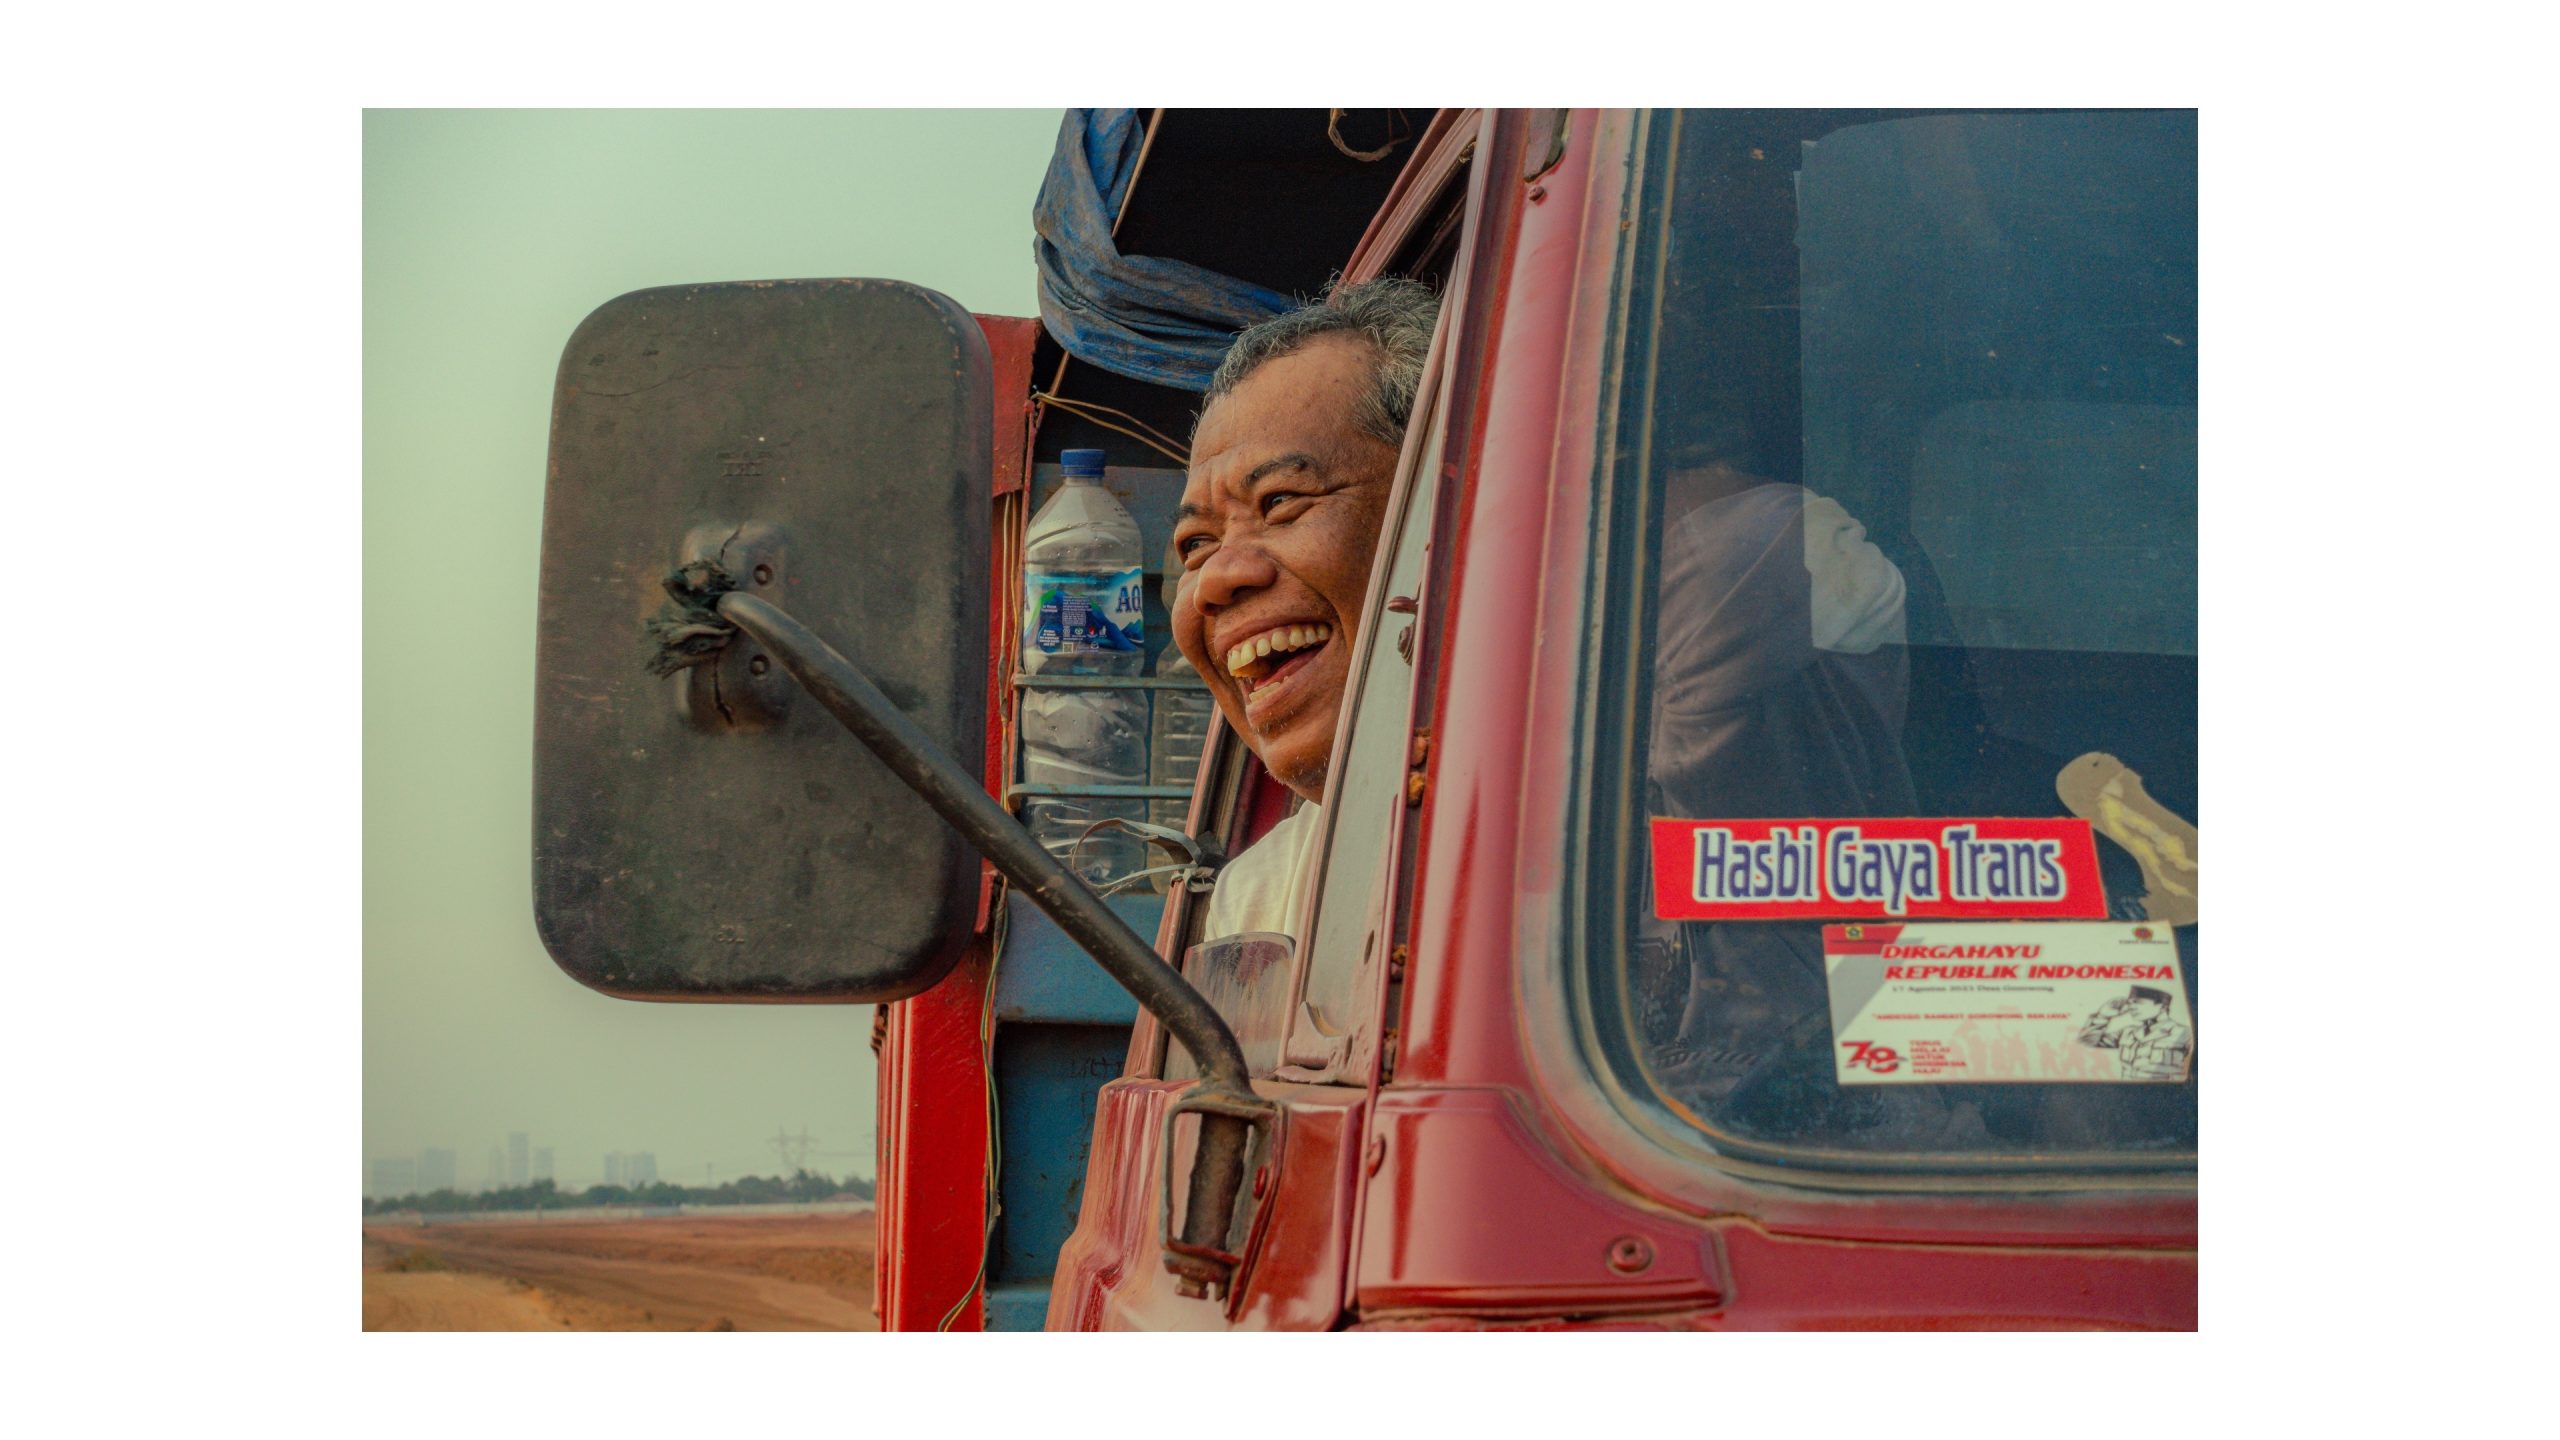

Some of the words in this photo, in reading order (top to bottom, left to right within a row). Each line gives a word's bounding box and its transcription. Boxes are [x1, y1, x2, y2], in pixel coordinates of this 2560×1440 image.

[1696, 829, 1816, 900] Hasbi
[1829, 829, 1937, 912] Gaya
[1945, 827, 2063, 900] Trans
[1881, 944, 2041, 960] DIRGAHAYU
[1885, 964, 2019, 980] REPUBLIK
[2028, 964, 2175, 980] INDONESIA
